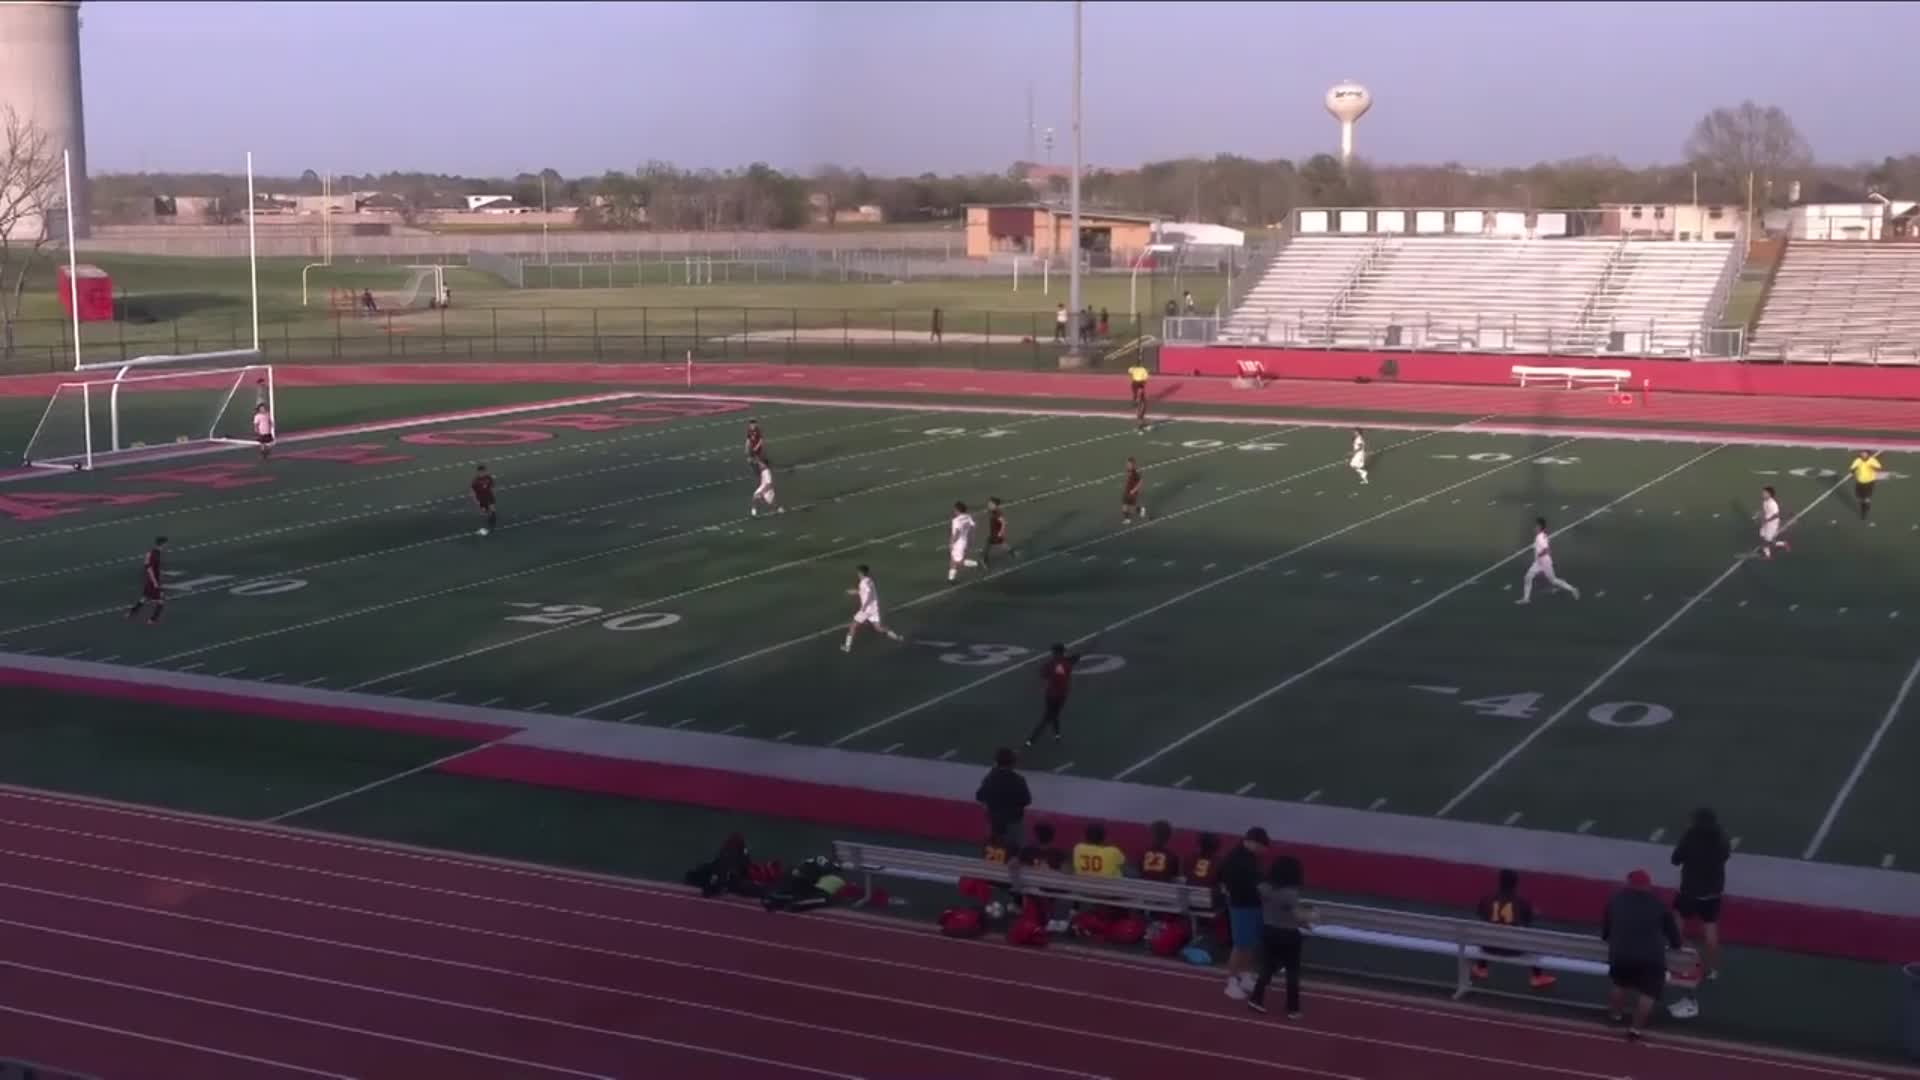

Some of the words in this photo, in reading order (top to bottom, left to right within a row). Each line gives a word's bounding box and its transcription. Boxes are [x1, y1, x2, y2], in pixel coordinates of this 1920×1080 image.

[504, 604, 681, 631] 20
[1460, 690, 1673, 727] 40
[1080, 854, 1103, 872] 30
[1491, 901, 1513, 923] 14
